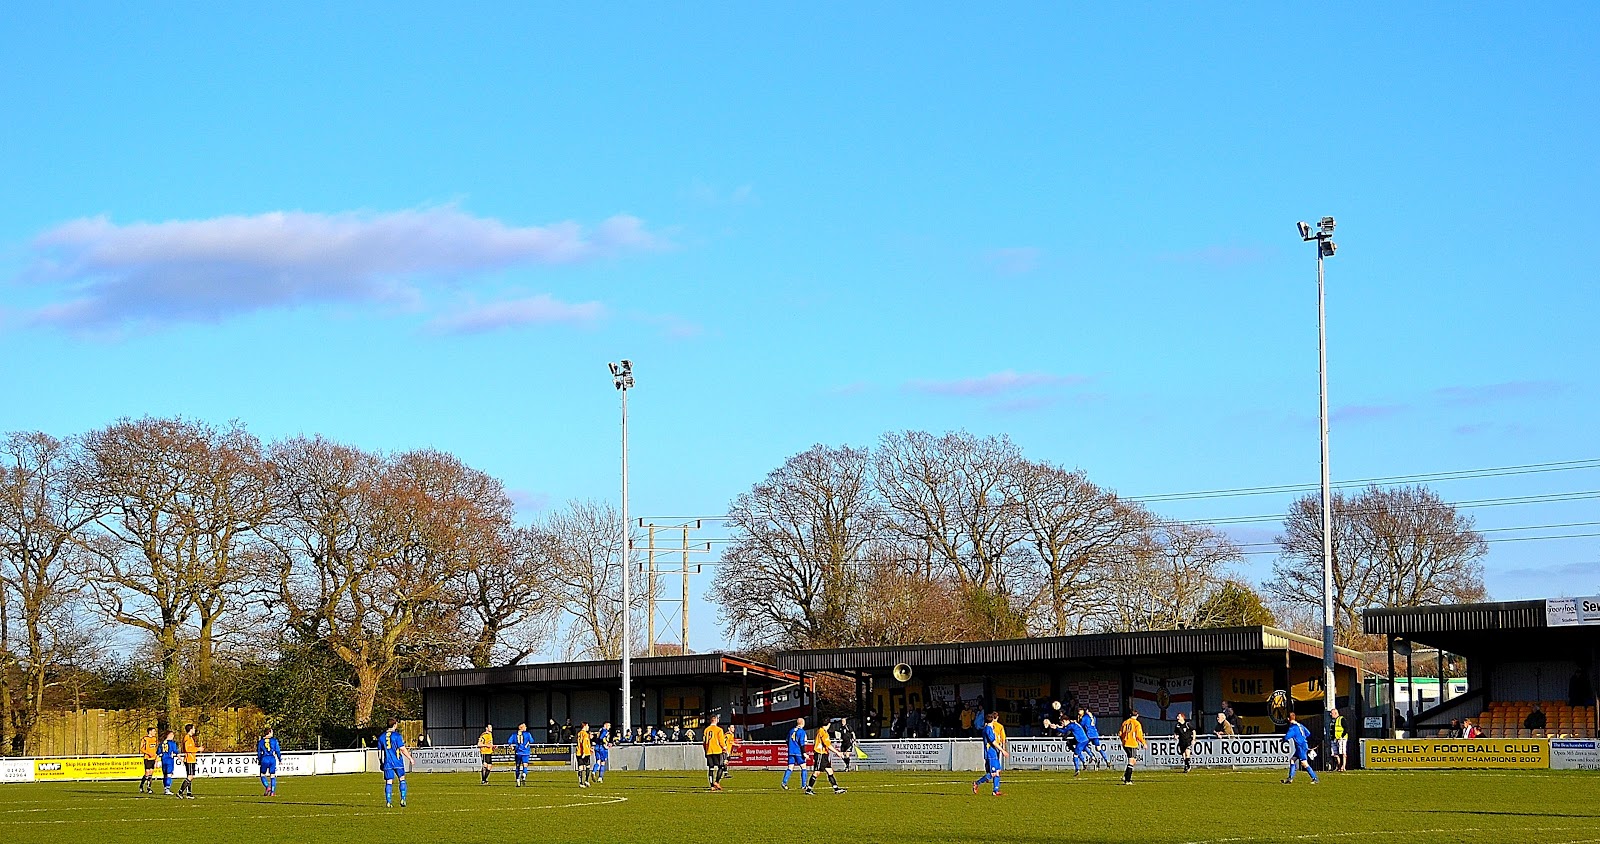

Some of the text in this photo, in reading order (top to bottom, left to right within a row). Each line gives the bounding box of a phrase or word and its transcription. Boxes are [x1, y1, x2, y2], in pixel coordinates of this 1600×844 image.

[1183, 679, 1193, 687] FC
[1232, 679, 1263, 695] COME
[1011, 744, 1029, 753] NEW
[1031, 744, 1063, 753] MILTON
[1151, 741, 1213, 756] BRECON
[1221, 740, 1290, 755] ROOFING
[1371, 744, 1540, 754] BASHLEY FOOTBALL CLUB
[175, 757, 206, 766] GRY
[195, 766, 249, 774] HAULAGE
